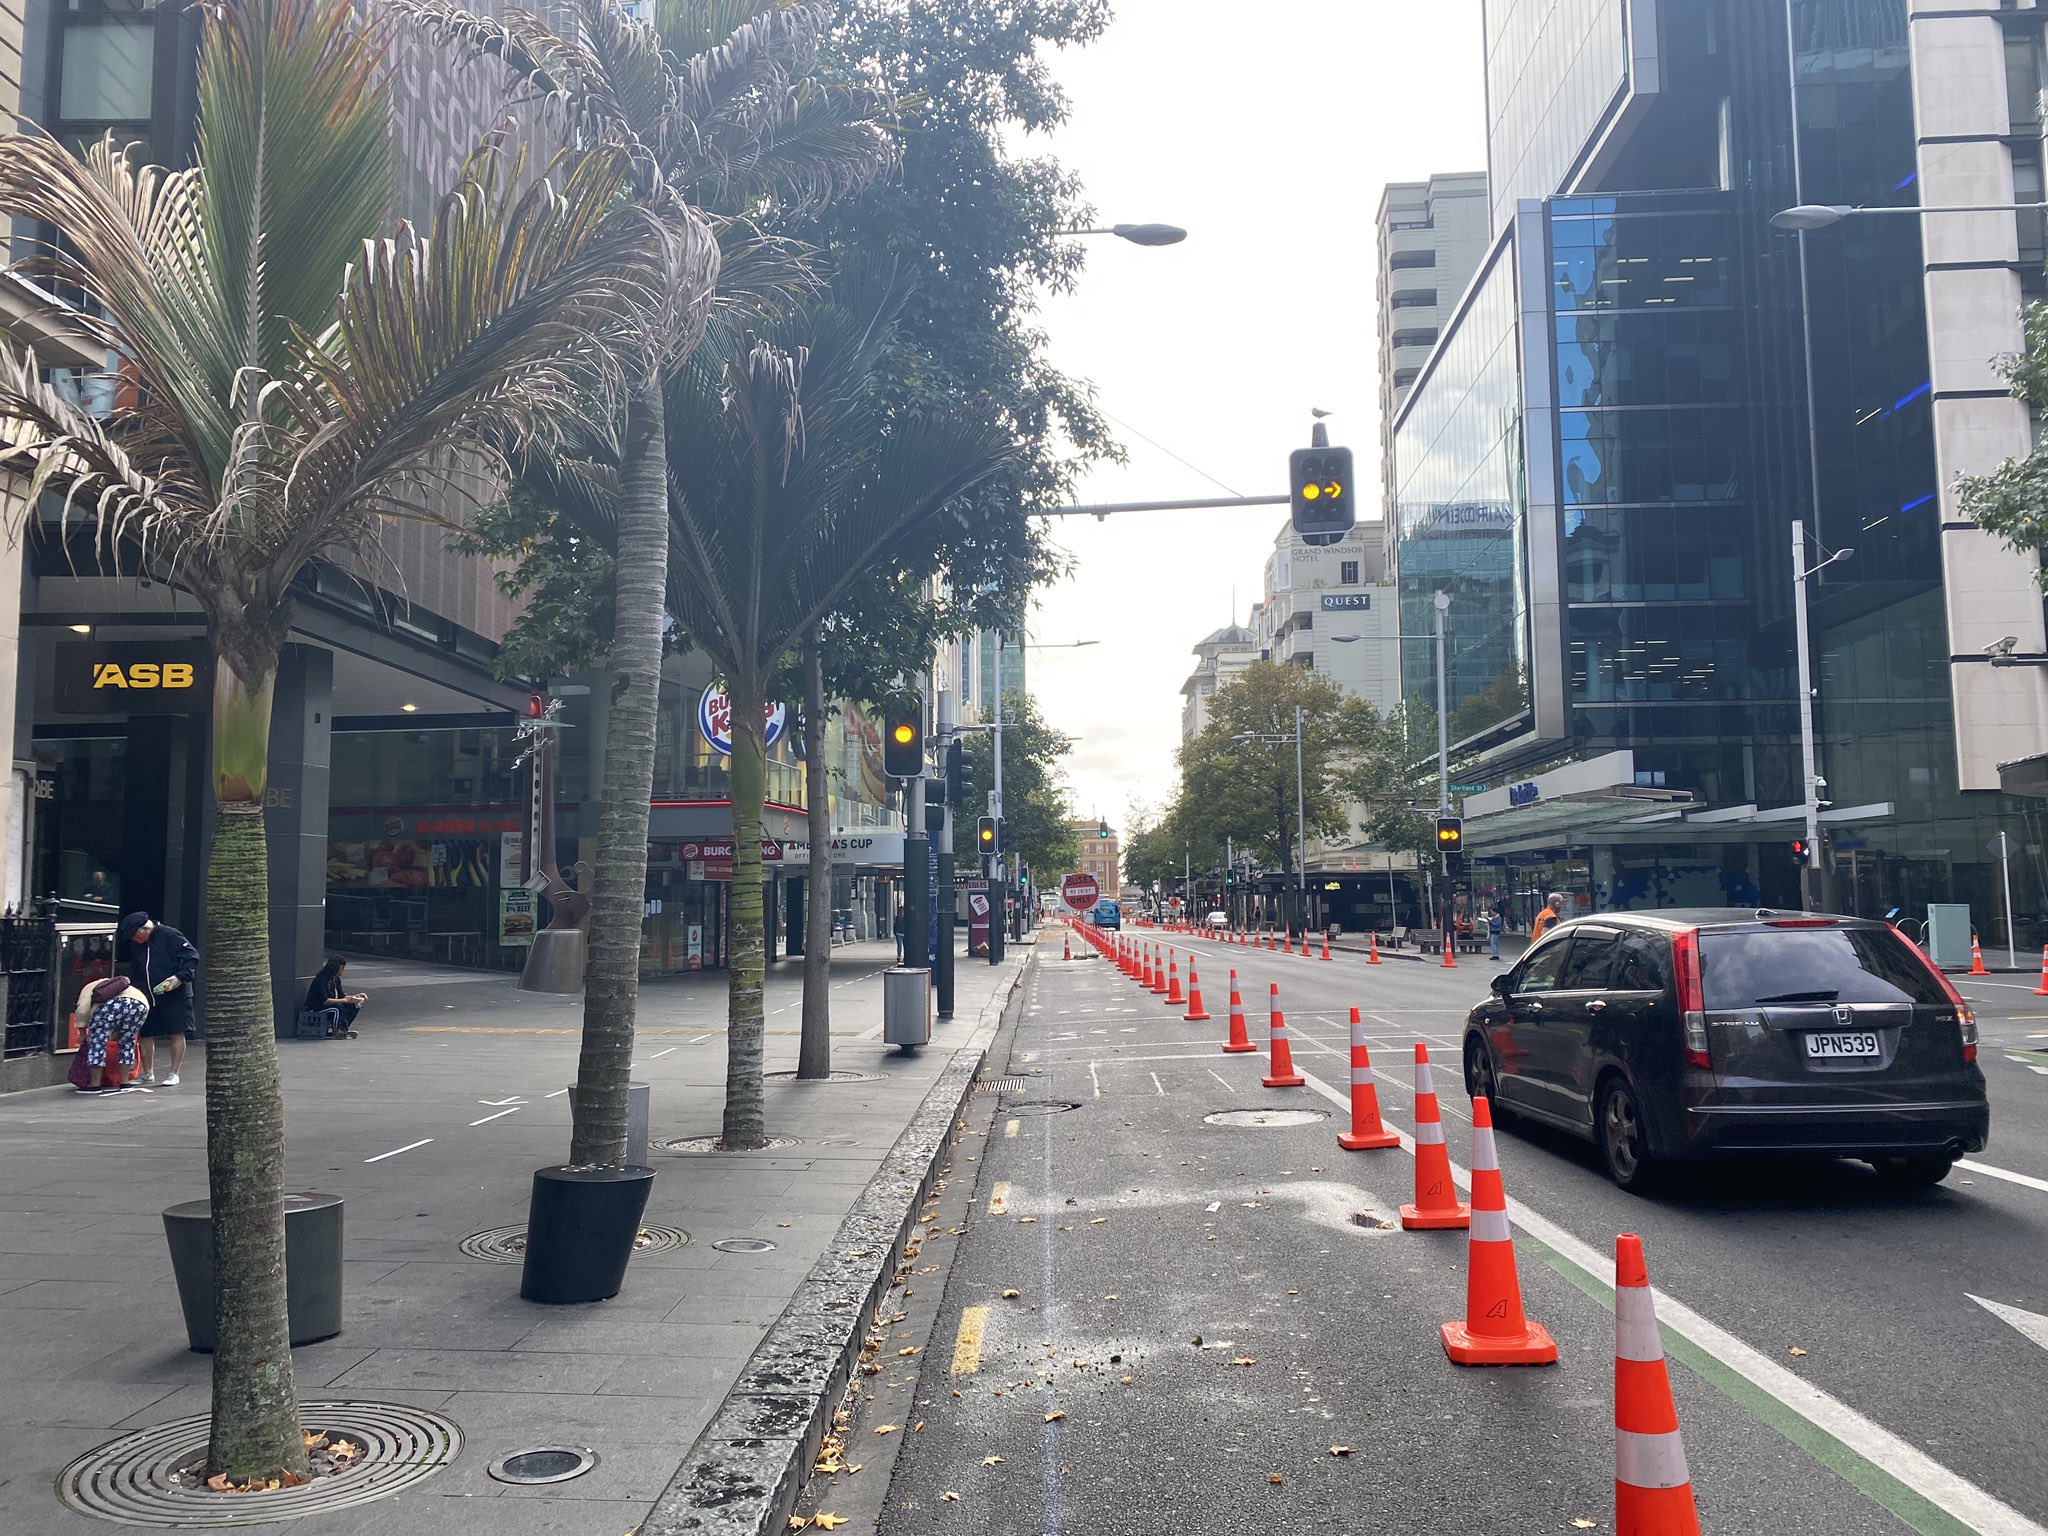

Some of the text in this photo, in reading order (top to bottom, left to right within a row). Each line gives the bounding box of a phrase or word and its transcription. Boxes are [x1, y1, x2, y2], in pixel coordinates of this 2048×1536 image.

[1292, 546, 1364, 555] GRAND WINDSOR
[1324, 596, 1367, 607] QUEST
[93, 663, 194, 689] ASB
[266, 788, 292, 807] BE
[850, 839, 873, 849] CUP
[1066, 875, 1093, 886] BUSES
[1070, 896, 1090, 904] ONLY
[1810, 1036, 1876, 1054] JPN539
